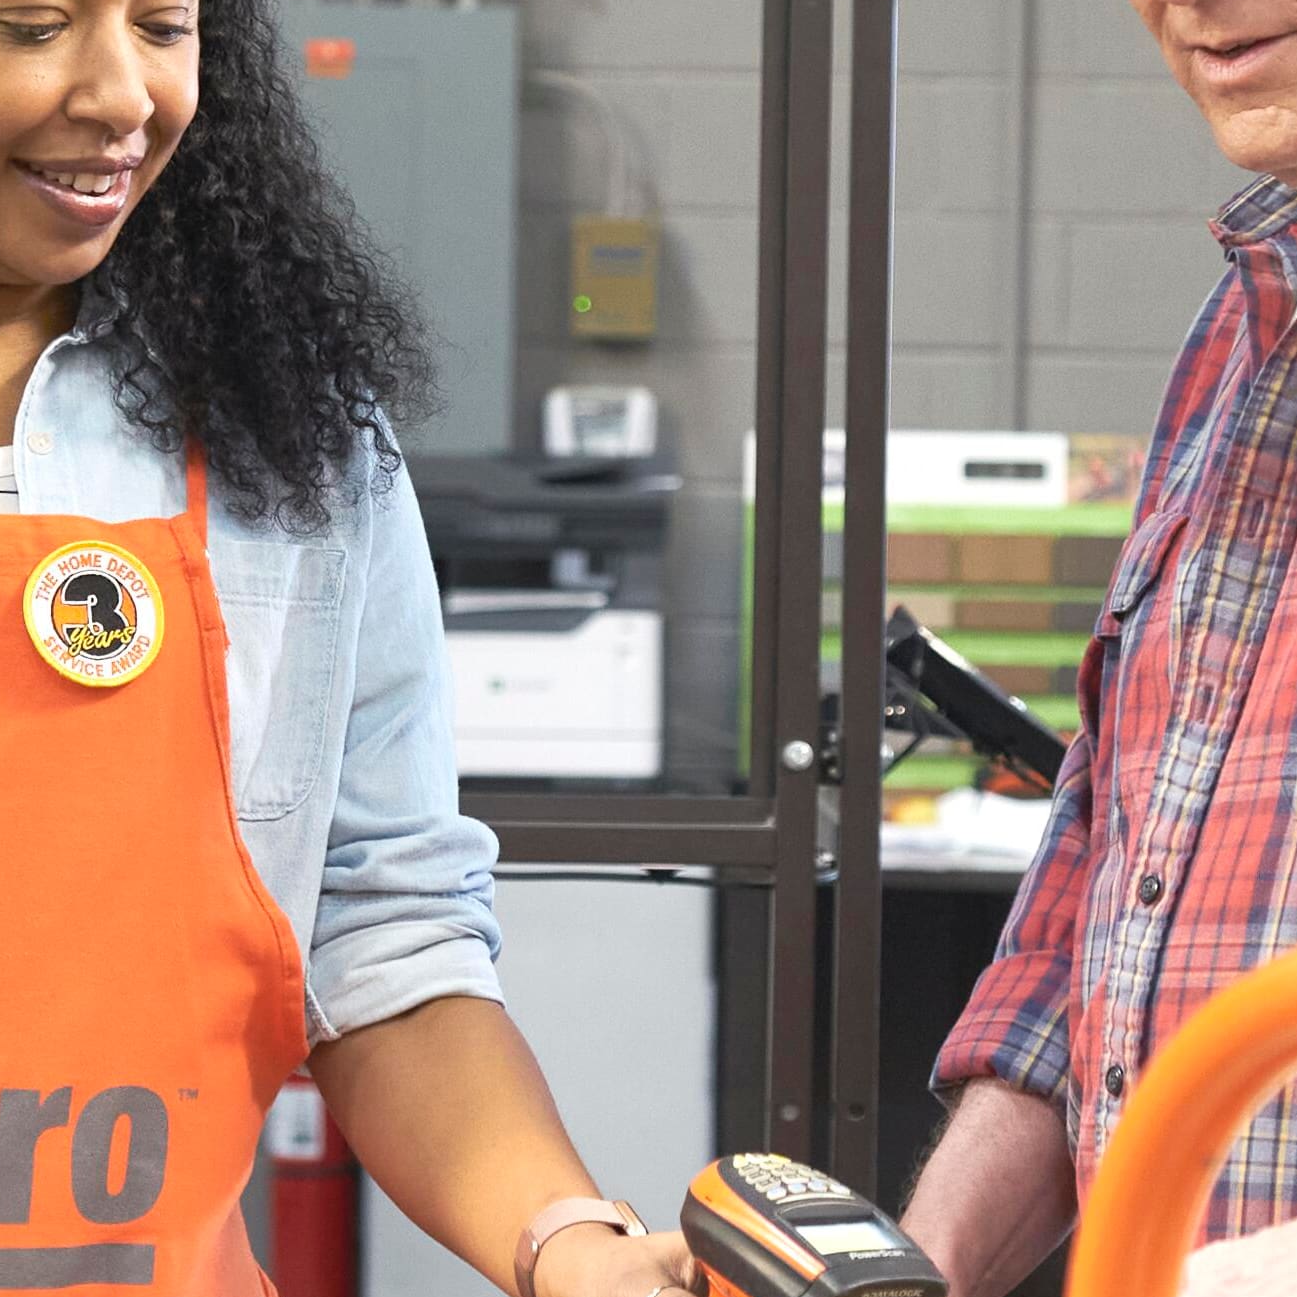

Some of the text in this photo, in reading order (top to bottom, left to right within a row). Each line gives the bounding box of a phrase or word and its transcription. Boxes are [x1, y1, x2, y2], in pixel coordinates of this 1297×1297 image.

[36, 553, 150, 601] THE HOME DEPOT
[63, 572, 130, 658] 3
[44, 635, 151, 677] SERVICE AWARD
